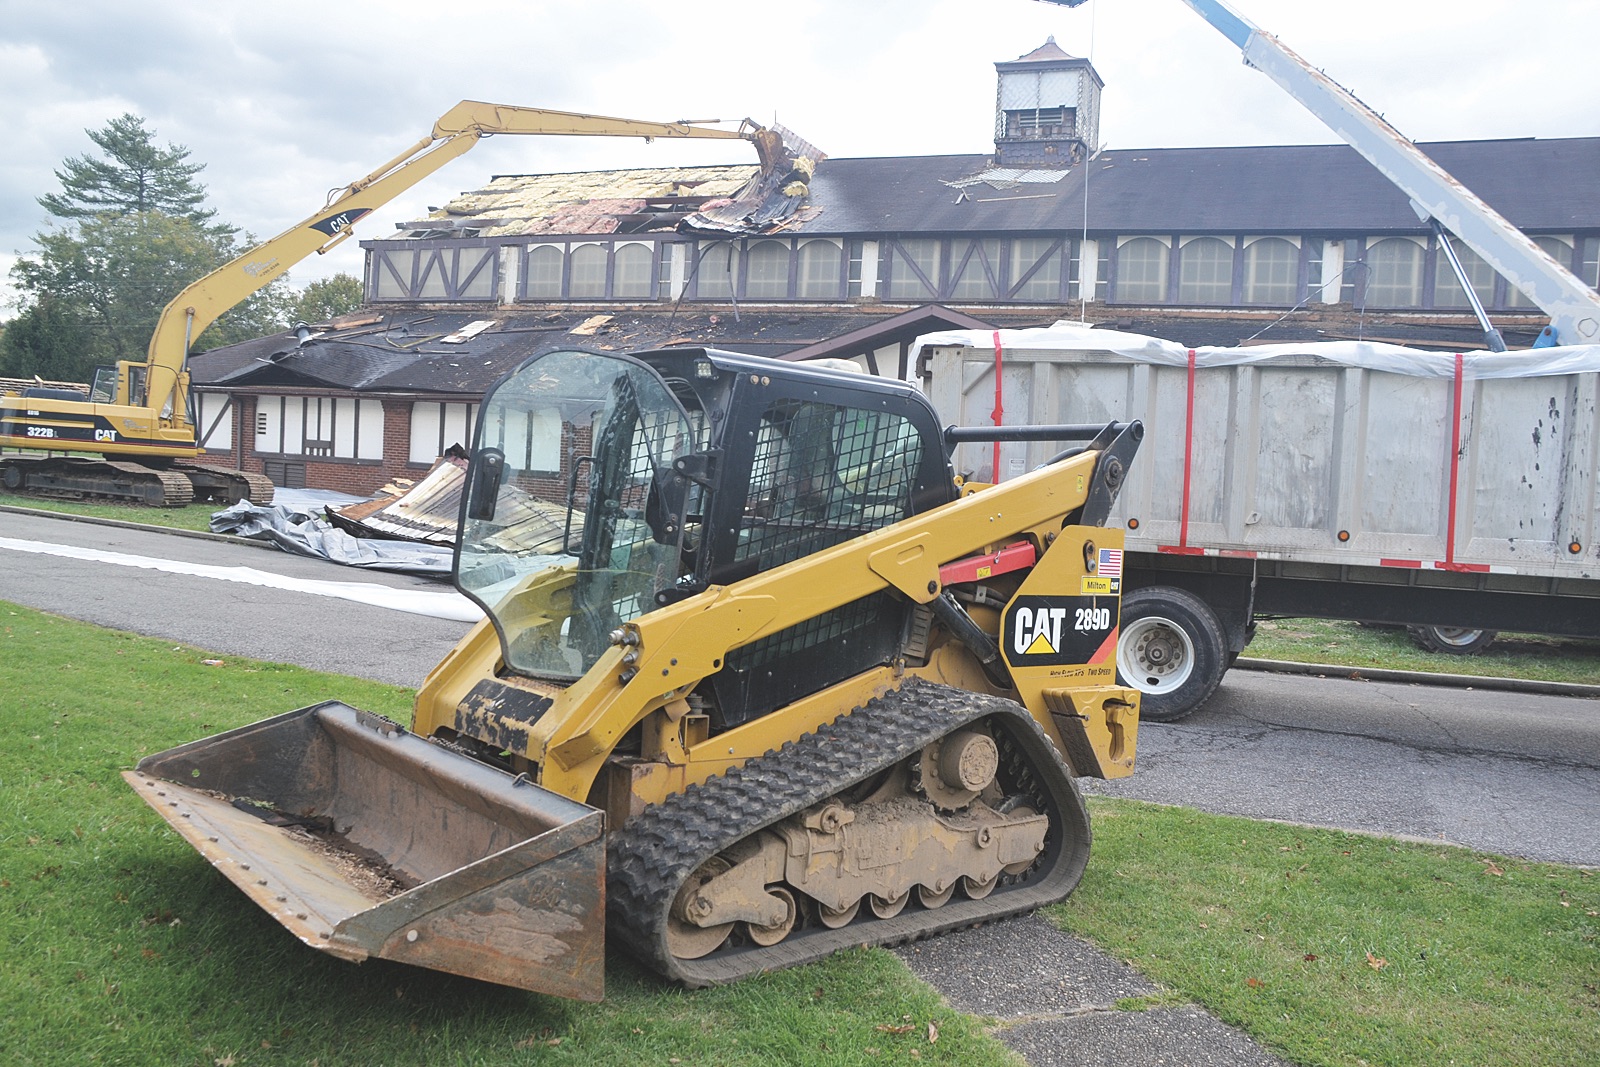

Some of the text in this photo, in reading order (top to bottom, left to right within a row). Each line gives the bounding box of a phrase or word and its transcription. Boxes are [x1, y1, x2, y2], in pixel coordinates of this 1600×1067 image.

[330, 213, 350, 233] CAT
[27, 426, 53, 438] 322B
[95, 429, 117, 442] CAT
[1087, 581, 1106, 590] Milton
[1014, 607, 1110, 655] CAT 289D
